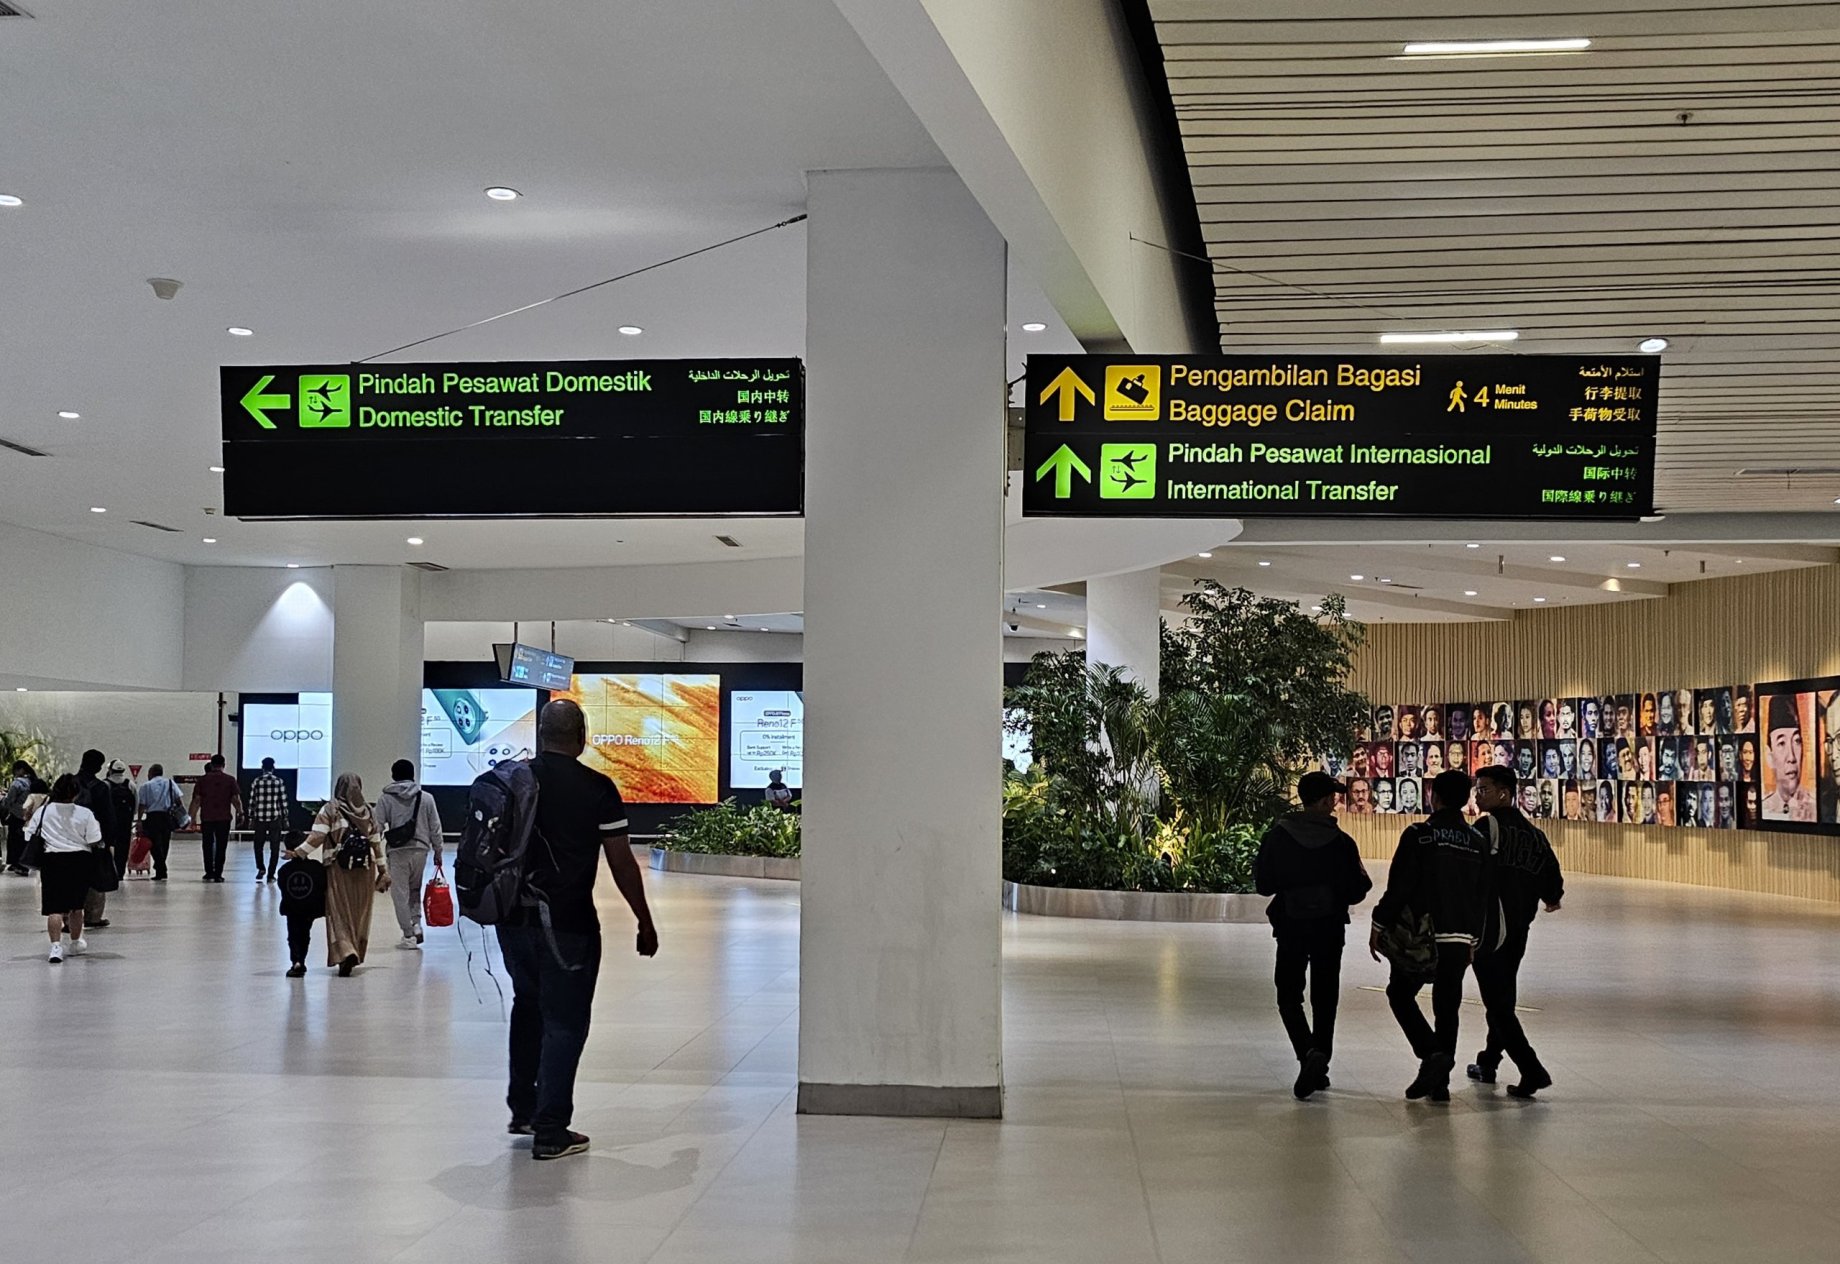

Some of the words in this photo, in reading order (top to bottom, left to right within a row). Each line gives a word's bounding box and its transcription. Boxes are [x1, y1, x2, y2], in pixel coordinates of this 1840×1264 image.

[688, 369, 721, 383] الداخلية
[722, 369, 761, 383] الرحلات
[762, 368, 790, 382] تحويل
[1170, 364, 1328, 392] Pengambilan
[1336, 363, 1421, 392] Bagasi
[1578, 364, 1613, 378] الأمتعة
[1614, 366, 1644, 381] استلام
[358, 372, 436, 395] Pindah
[443, 372, 540, 394] Pesawat
[546, 370, 653, 393] Domestik
[1494, 383, 1526, 395] Menit
[737, 389, 790, 404] 国内中转
[1473, 385, 1490, 408] 4
[1584, 385, 1642, 401] 行李提取
[1494, 398, 1538, 410] Minutes
[359, 406, 464, 428] Domestic
[468, 404, 565, 427] Transfer
[699, 409, 790, 425] 国内線乗り継ぎ
[1169, 399, 1278, 428] Baggage
[1285, 398, 1355, 422] Claim
[1568, 406, 1641, 422] 手荷物受取
[1168, 442, 1243, 464] Pindah
[1249, 442, 1344, 465] Pesawat
[1350, 443, 1491, 465] Internasional
[1532, 443, 1563, 457] الدولية
[1565, 444, 1607, 458] الرحلات
[1609, 444, 1639, 458] تحويل
[1583, 466, 1638, 480] 国际中转
[1167, 479, 1300, 500] International
[1305, 480, 1399, 501] Transfer
[1541, 489, 1637, 504] 国際線乗り継ぎ
[757, 718, 789, 728] Reno12
[270, 729, 324, 743] oppo
[592, 734, 624, 746] OPPO
